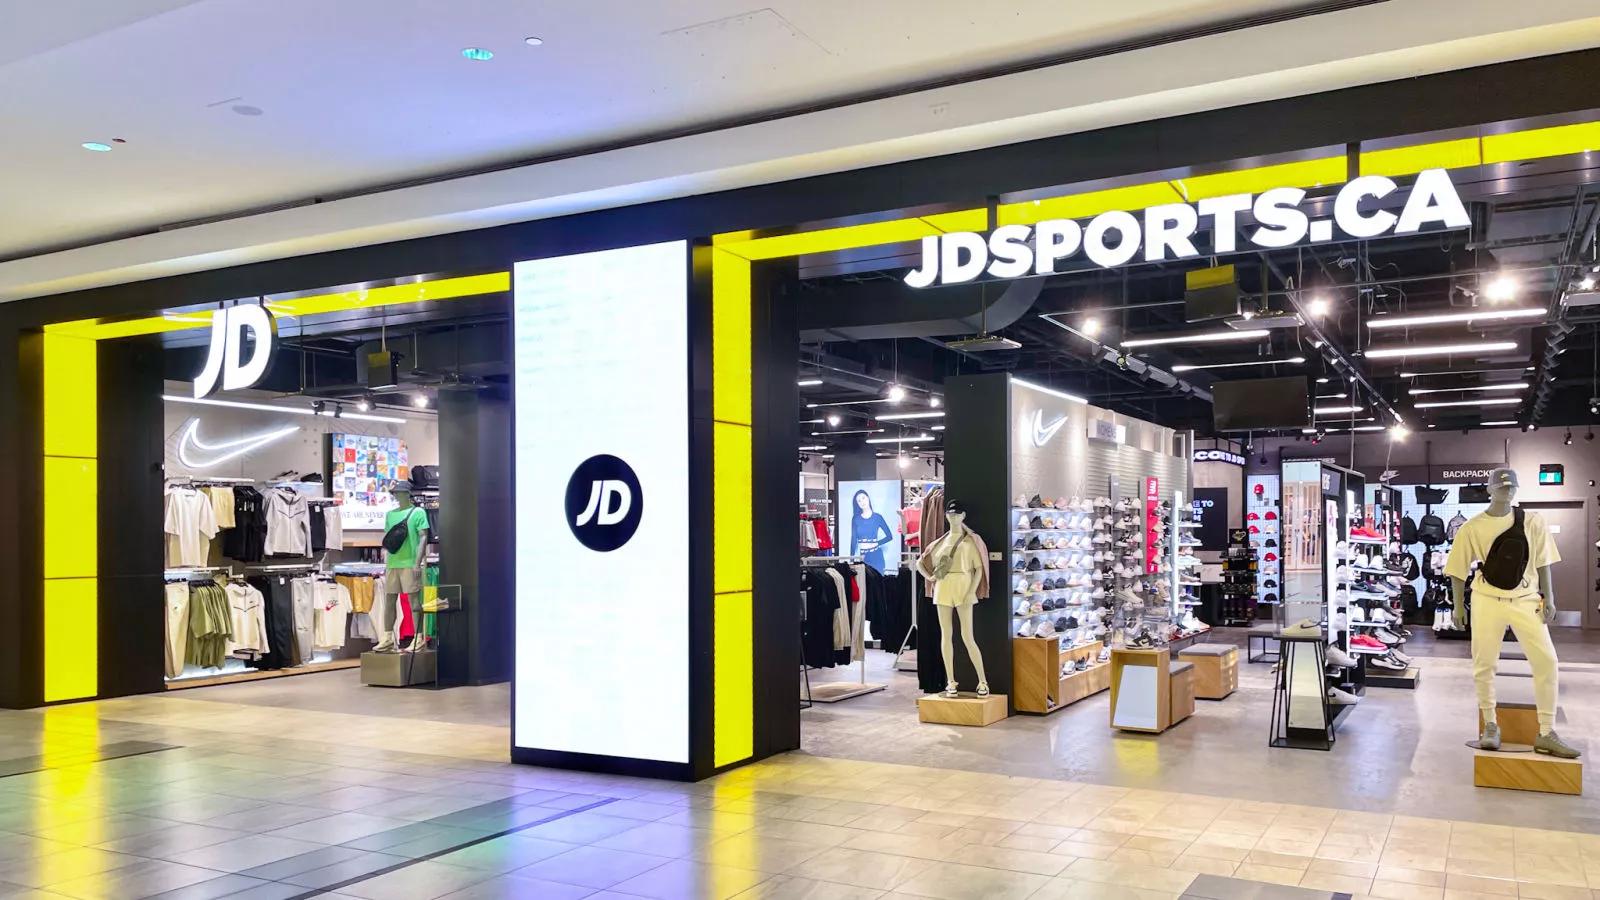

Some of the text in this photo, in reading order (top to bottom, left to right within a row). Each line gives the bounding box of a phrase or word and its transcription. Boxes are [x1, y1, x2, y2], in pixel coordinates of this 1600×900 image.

[904, 168, 1472, 288] JDSPORTS.CA
[193, 303, 274, 399] JD
[576, 479, 632, 526] JD
